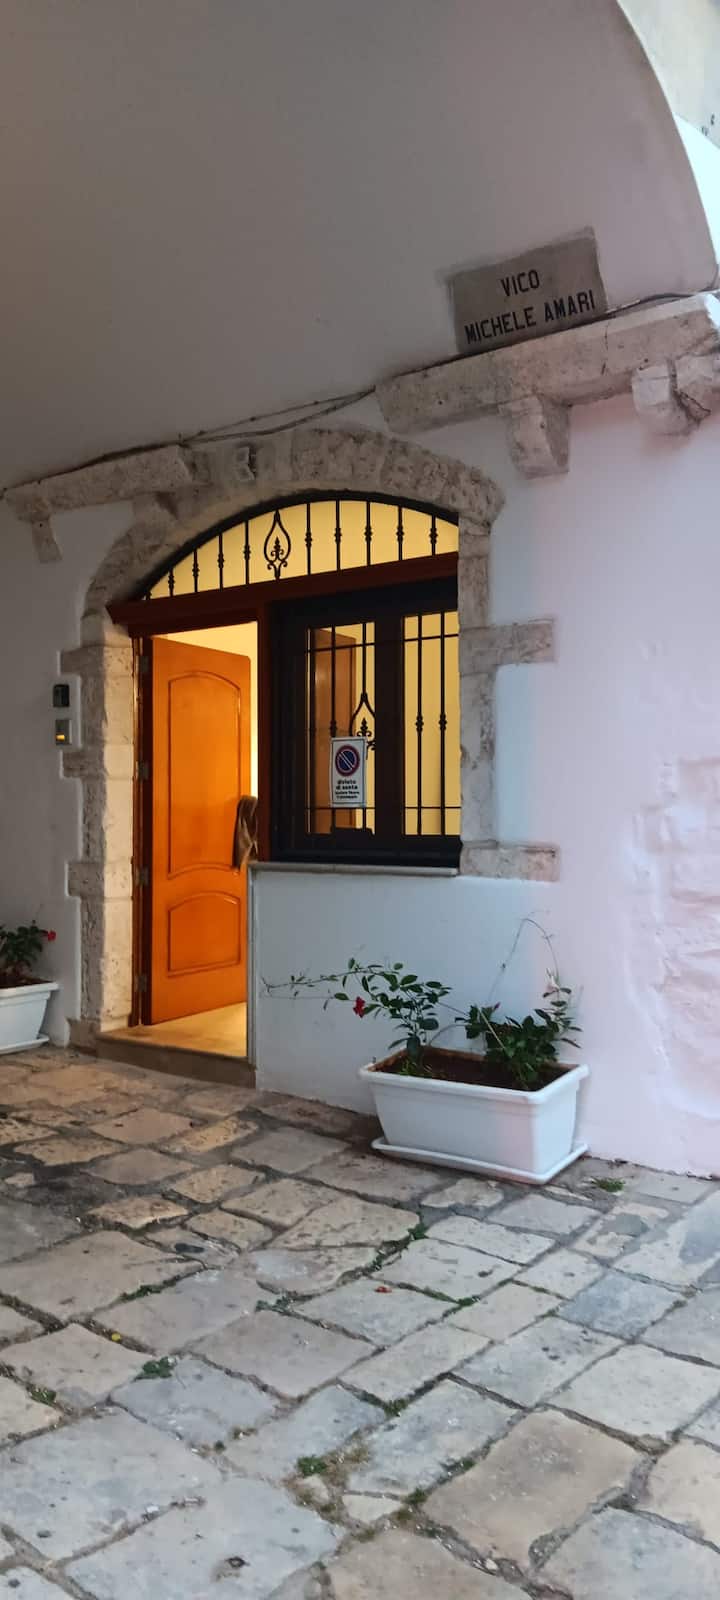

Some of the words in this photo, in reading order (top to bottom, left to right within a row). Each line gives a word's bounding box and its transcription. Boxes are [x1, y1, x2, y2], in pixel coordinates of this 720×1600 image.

[500, 269, 540, 297] VICO
[464, 306, 537, 345] MICHELE
[544, 289, 596, 323] AMARI
